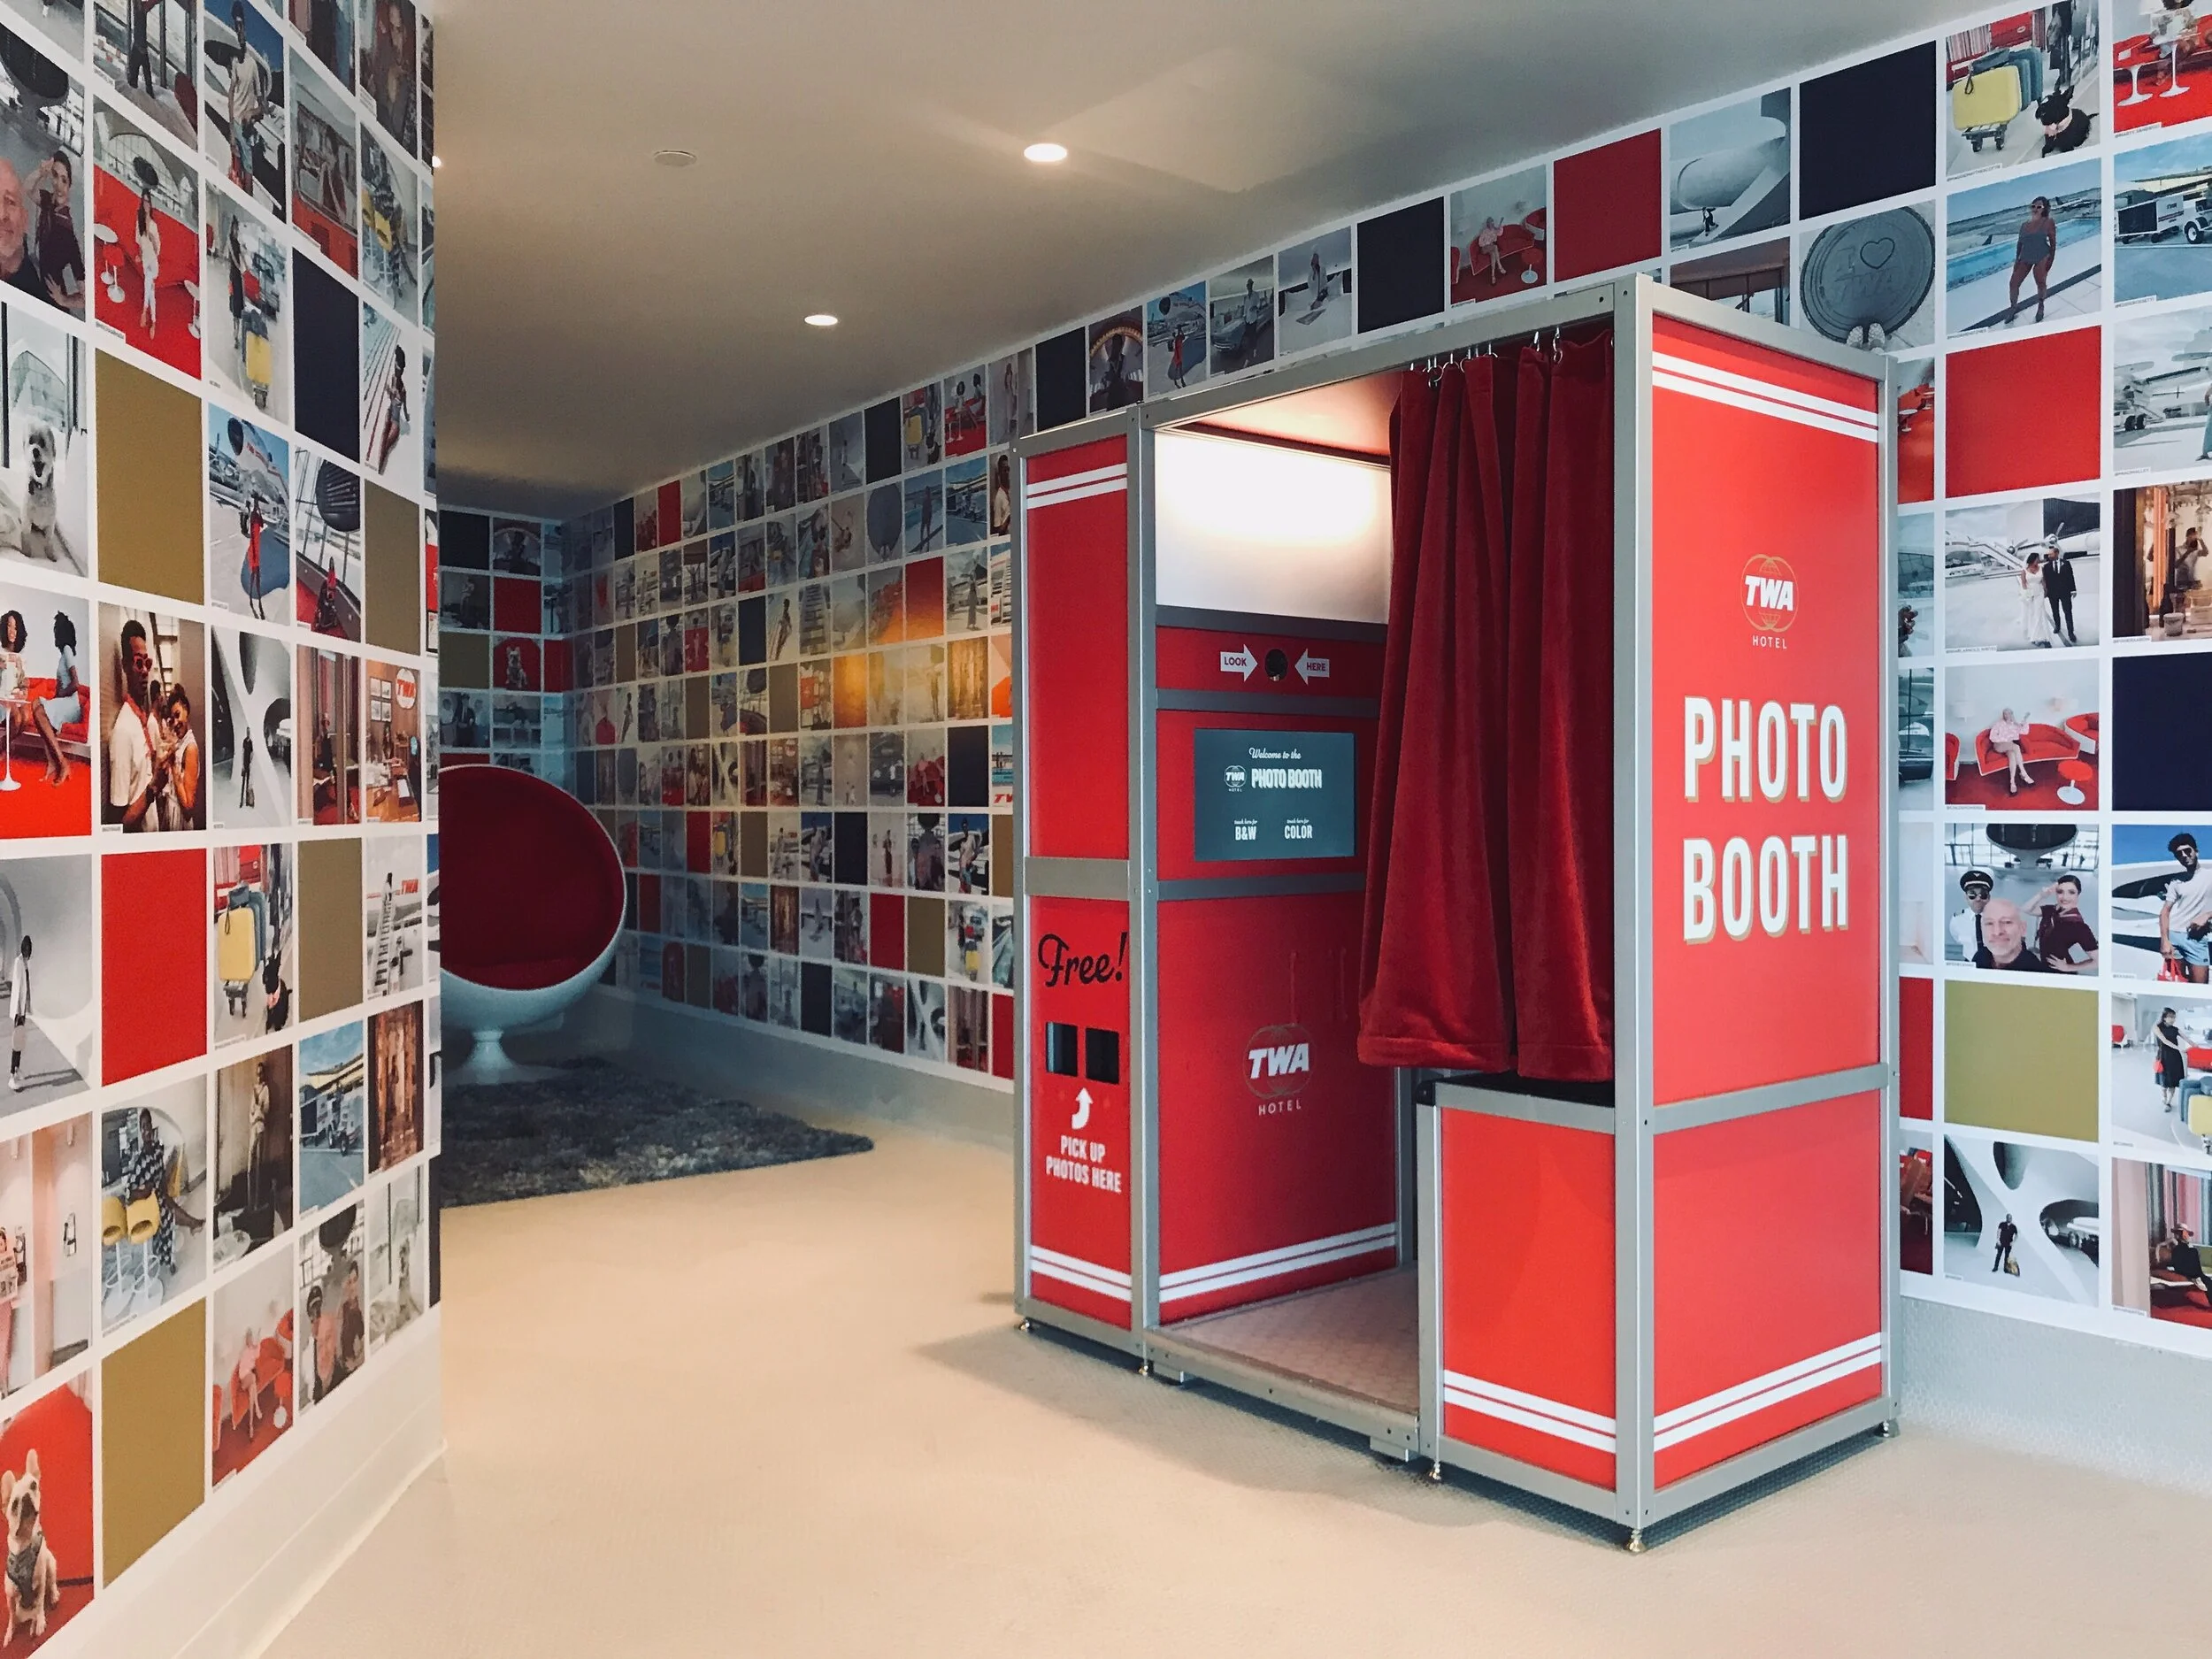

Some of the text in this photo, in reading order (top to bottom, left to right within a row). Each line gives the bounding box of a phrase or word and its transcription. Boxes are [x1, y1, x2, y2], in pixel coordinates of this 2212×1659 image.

[1744, 574, 1793, 611] TWA
[1752, 634, 1787, 649] HOTEL
[1224, 656, 1247, 667] LOOK
[1306, 662, 1326, 672] HERE
[1248, 747, 1302, 760] Welcome to the
[1683, 695, 1847, 803] PHOTO
[1225, 772, 1245, 781] TWA
[1251, 768, 1323, 789] PHOTO BOOTH
[994, 794, 1013, 803] TW
[1234, 826, 1257, 841] B&W
[1284, 825, 1313, 840] COLOR
[1682, 833, 1849, 946] BOOTH
[1037, 932, 1128, 987] Free!
[1248, 1042, 1310, 1079] TWA
[1258, 1100, 1302, 1117] HOTEL
[1060, 1135, 1106, 1164] PICK UP
[1045, 1156, 1123, 1194] PHOTOS HERE
